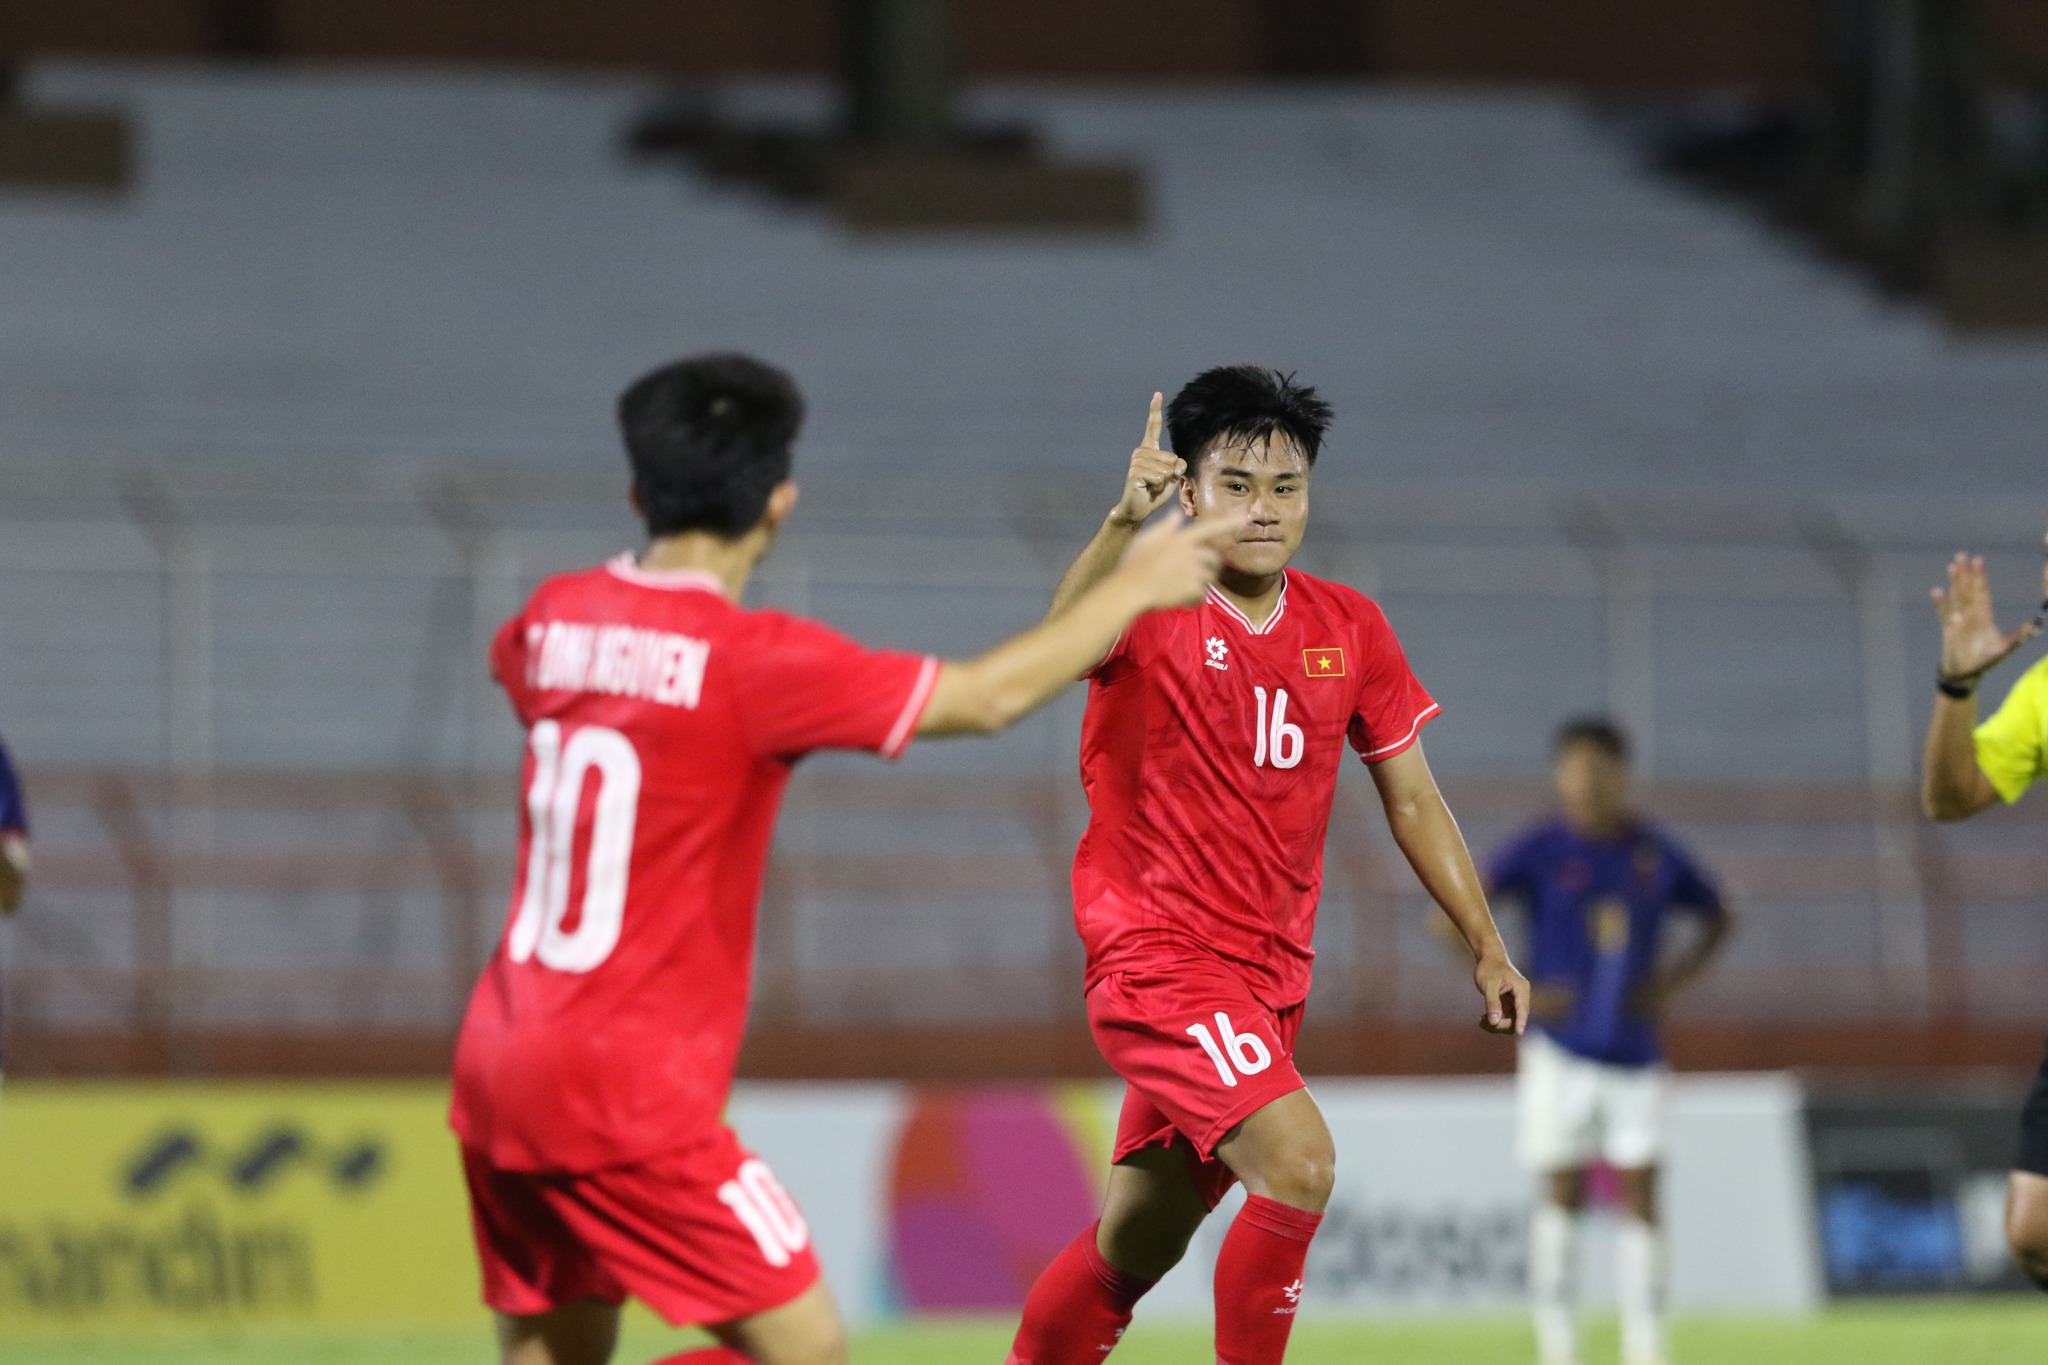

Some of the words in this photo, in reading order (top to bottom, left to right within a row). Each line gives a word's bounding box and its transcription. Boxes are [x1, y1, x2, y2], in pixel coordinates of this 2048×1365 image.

[1253, 686, 1304, 769] 16
[507, 718, 642, 974] 10
[1185, 1011, 1272, 1088] 16
[716, 1158, 809, 1268] 10
